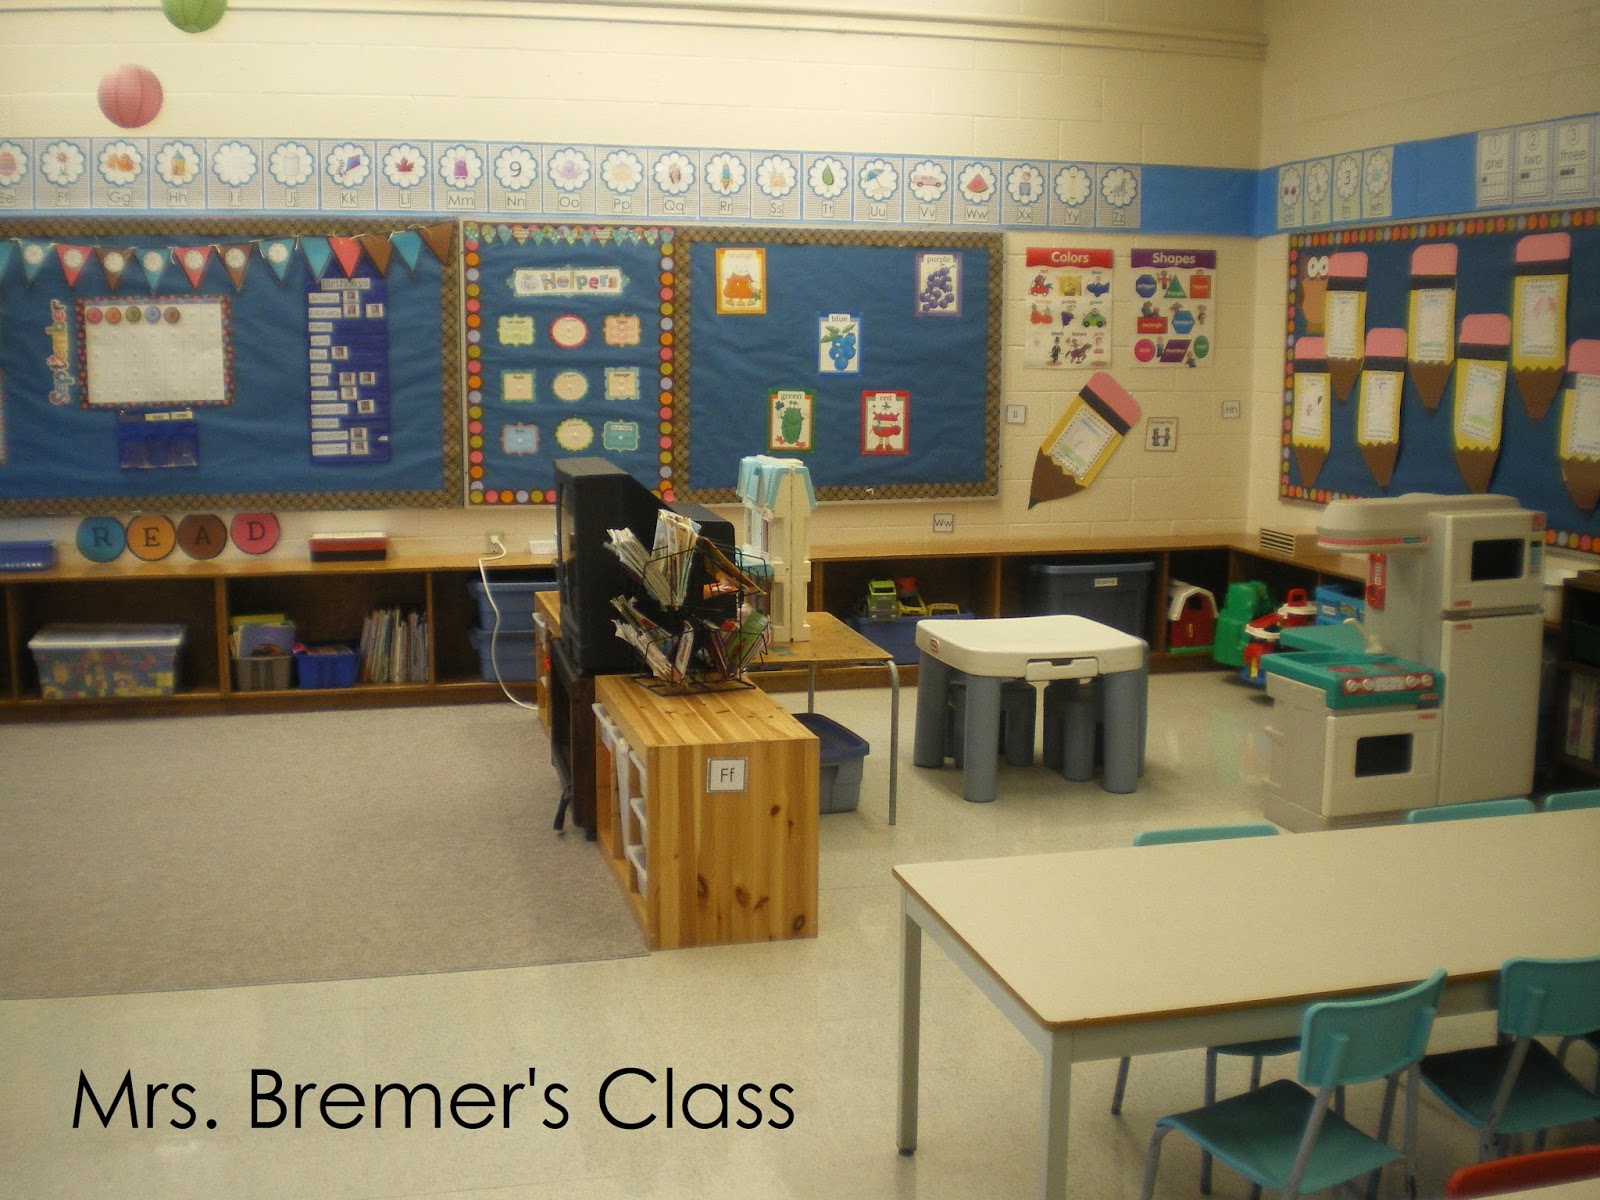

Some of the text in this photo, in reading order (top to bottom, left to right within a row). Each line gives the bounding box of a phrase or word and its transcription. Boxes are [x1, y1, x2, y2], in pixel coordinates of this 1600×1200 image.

[1524, 154, 1542, 165] two
[1559, 149, 1587, 162] three
[509, 161, 522, 178] 9
[1486, 158, 1504, 170] one
[1344, 170, 1351, 186] 3
[109, 191, 131, 206] Gg
[169, 191, 187, 204] Hh
[341, 192, 356, 205] Kk
[448, 195, 474, 207] Mm
[507, 196, 525, 207] Nn
[559, 196, 580, 208] Oo
[613, 199, 630, 213] Pp
[664, 199, 684, 214] Qq
[720, 200, 732, 212] Rr
[770, 202, 782, 215] Ss
[823, 203, 833, 214] Tt
[870, 205, 886, 217] Uu
[919, 206, 936, 217] Vv
[966, 208, 989, 219] Ww
[1017, 209, 1032, 220] Xx
[1065, 210, 1079, 223] Yy
[1113, 211, 1125, 223] Zz
[926, 256, 951, 264] purple
[1051, 251, 1090, 263] Colors
[1152, 251, 1197, 266] Shapes
[540, 270, 619, 291] Helpers
[831, 315, 849, 323] blue
[46, 299, 75, 405] September
[780, 392, 803, 401] green
[880, 394, 893, 402] red
[934, 518, 953, 527] Ww
[93, 522, 266, 547] READ
[720, 767, 735, 783] Ff
